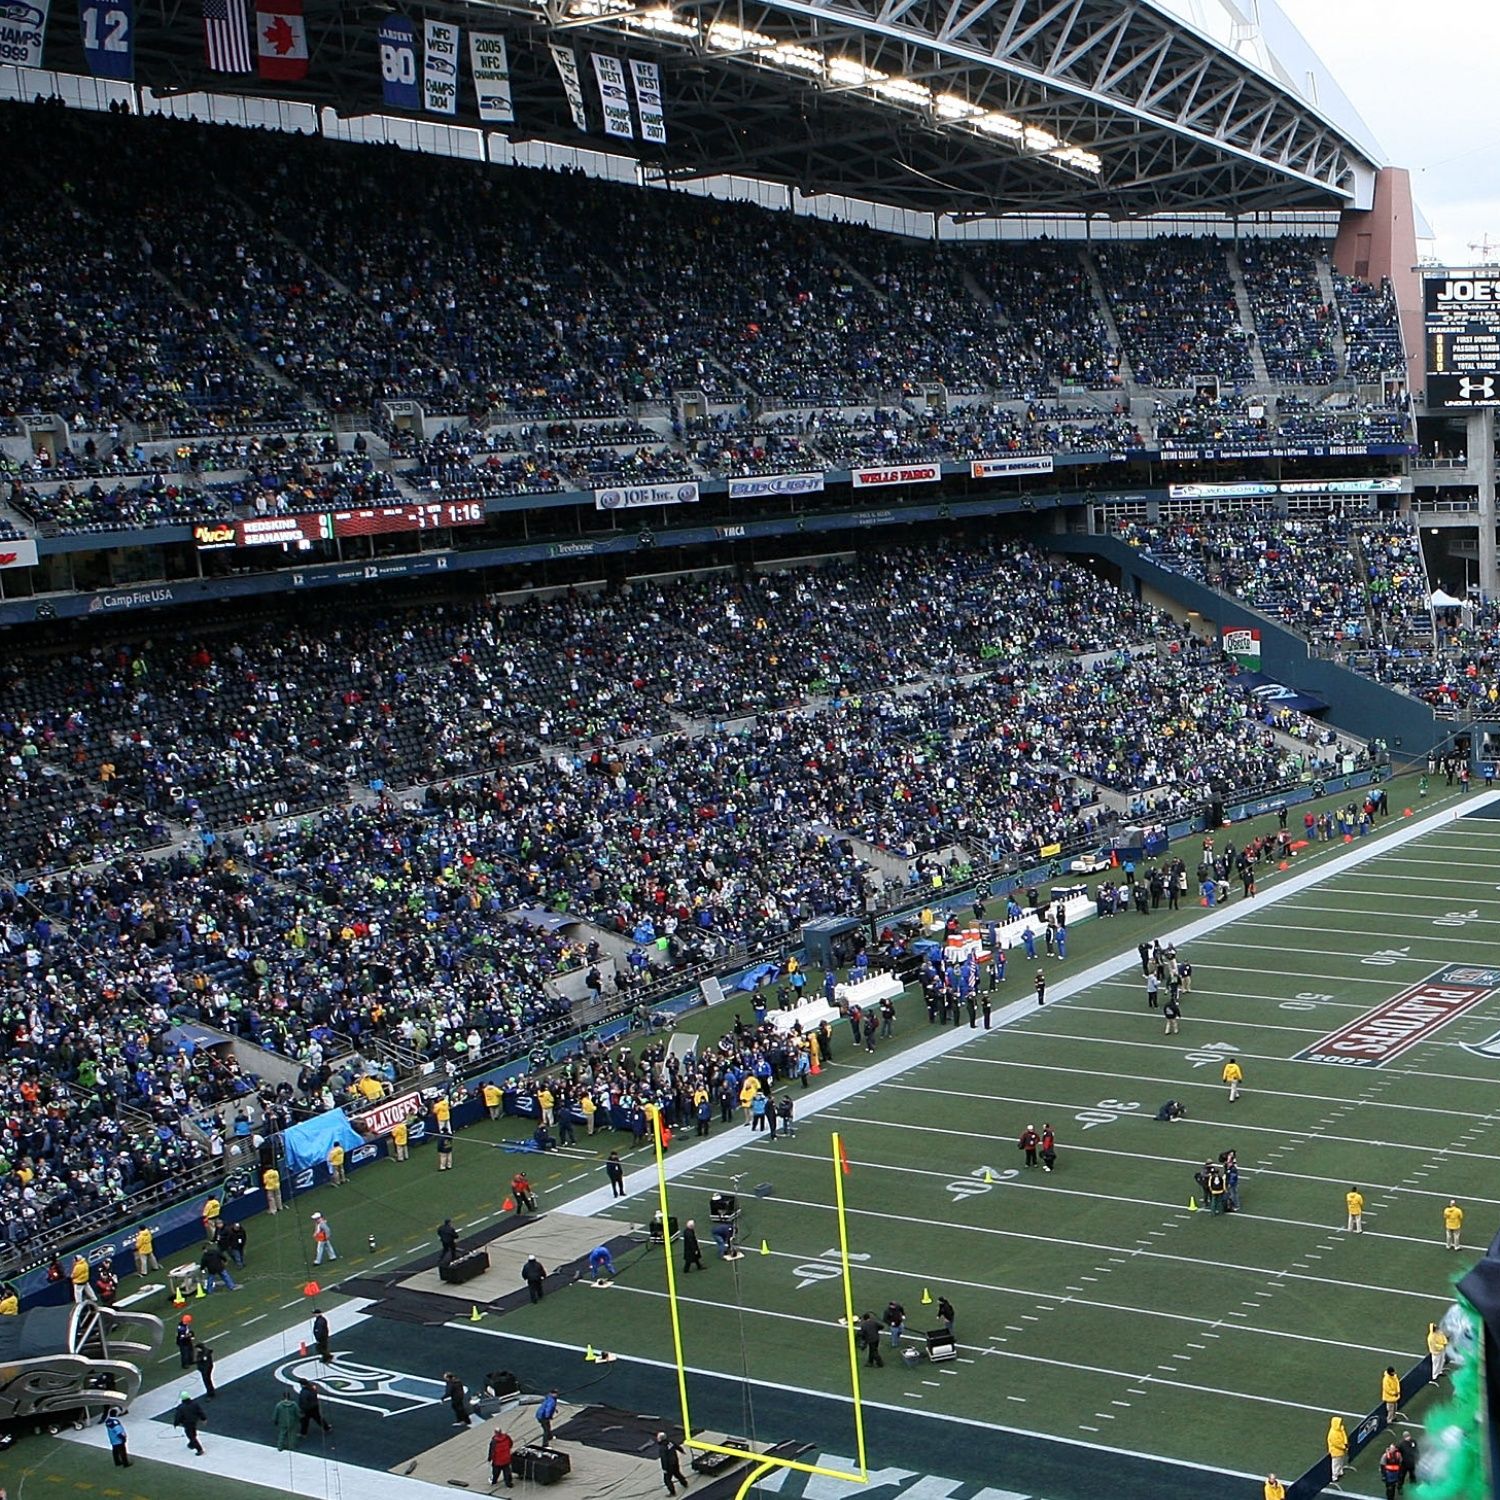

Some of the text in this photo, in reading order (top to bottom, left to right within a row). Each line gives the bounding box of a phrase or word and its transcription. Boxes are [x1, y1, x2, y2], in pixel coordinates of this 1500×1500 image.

[0, 27, 42, 47] HAMPS
[83, 7, 129, 52] 12
[433, 26, 450, 40] NFC
[0, 44, 28, 61] 999
[427, 39, 454, 54] WEST
[475, 39, 502, 53] 2005
[381, 44, 416, 85] 80
[481, 55, 500, 69] NFC
[598, 57, 616, 71] NFC
[600, 69, 621, 84] WEST
[636, 64, 653, 77] NFC
[426, 79, 455, 96] CHAMPS
[637, 75, 659, 90] WEST
[641, 111, 663, 126] CHAMP
[23, 416, 53, 426] 334
[1178, 450, 1199, 459] CLASSIC
[1347, 446, 1367, 455] CLASSIC
[859, 469, 936, 483] WELLS FARGO
[652, 489, 673, 500] Inc.
[731, 480, 821, 495] BUD LIGHT
[1261, 485, 1277, 493] TO
[1280, 483, 1328, 493] QWEST
[448, 504, 480, 522] 1:16
[244, 519, 296, 533] REDSKINS
[319, 514, 327, 526] 0
[245, 527, 328, 544] SEAHAWKS 0
[723, 526, 745, 537] YMCA
[558, 543, 594, 553] Treehouse
[365, 566, 378, 578] 12
[104, 589, 173, 607] Camp Fire USA
[1279, 991, 1334, 1011] 50
[1332, 987, 1476, 1054] PLAYOFFS
[1185, 1041, 1241, 1063] 40
[1307, 1054, 1373, 1065] 2007
[365, 1098, 418, 1131] PLAYOFFS
[1075, 1099, 1140, 1124] 30
